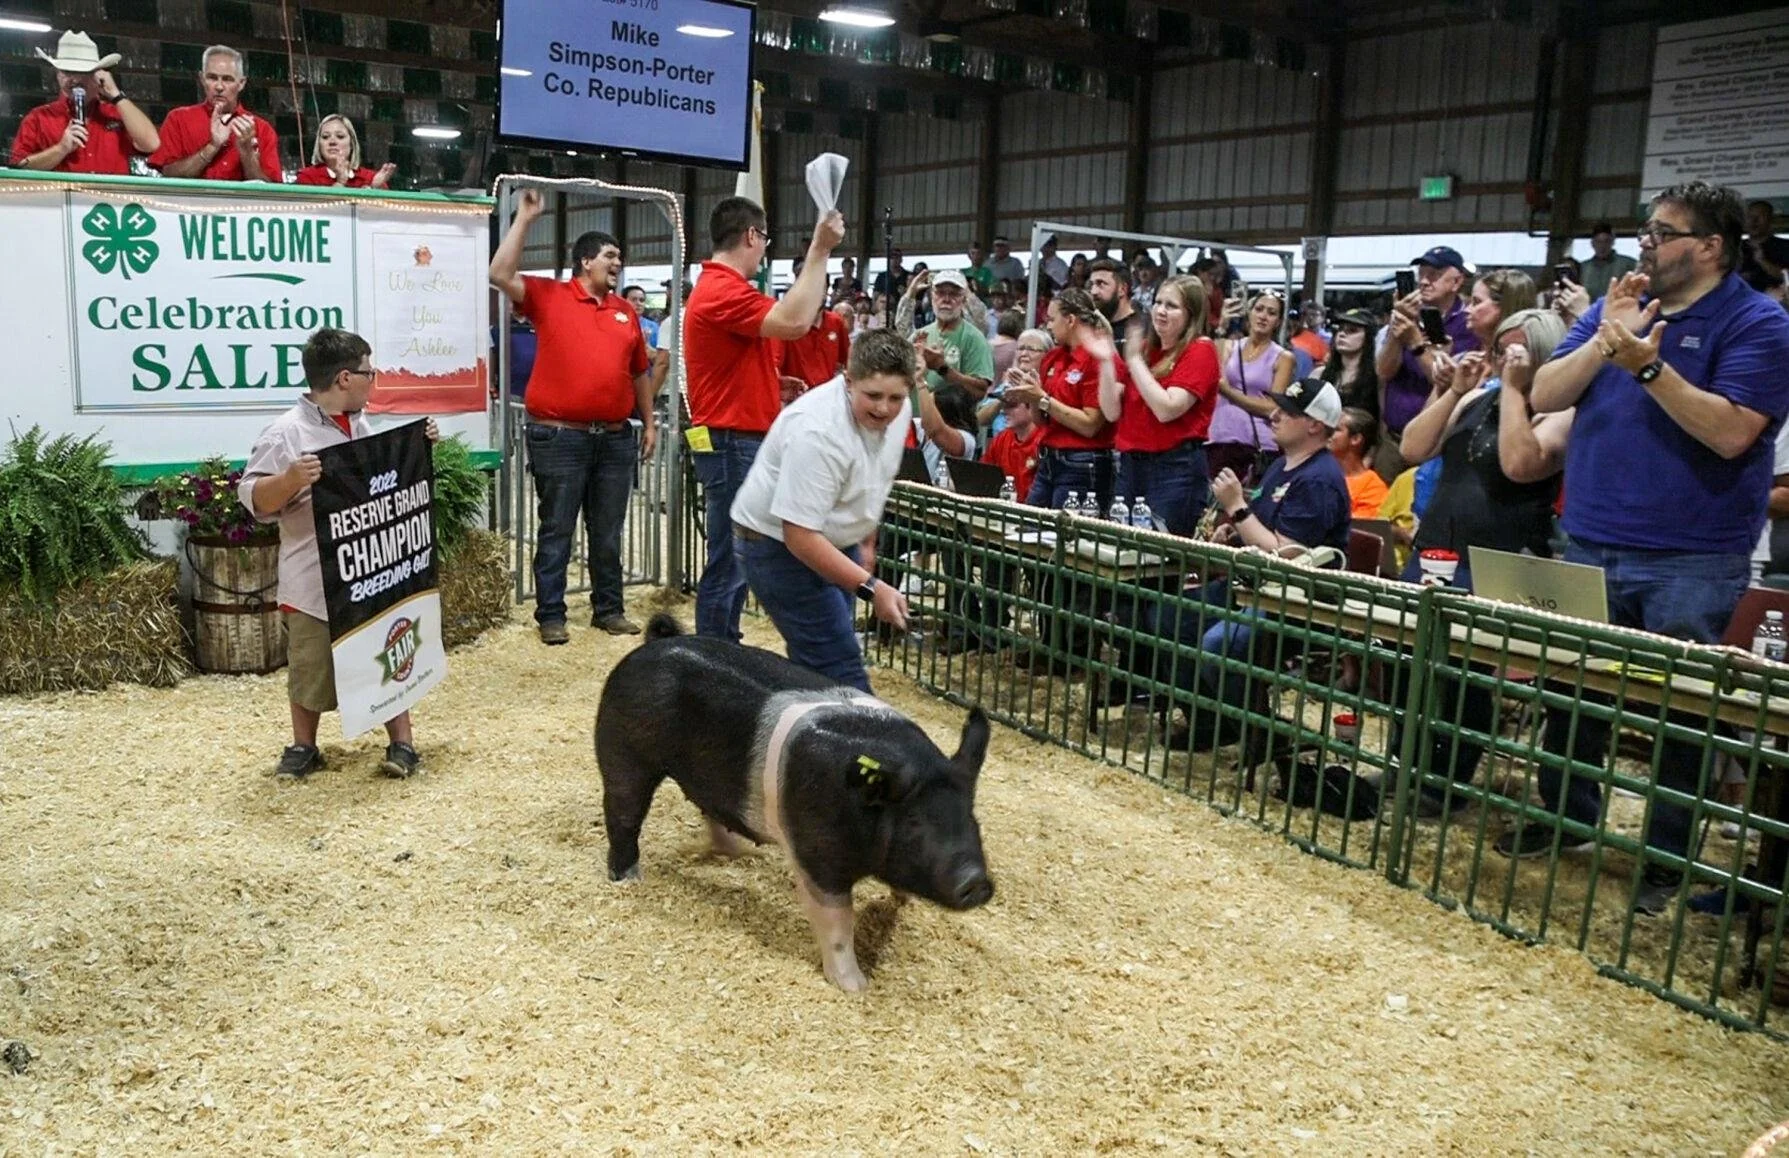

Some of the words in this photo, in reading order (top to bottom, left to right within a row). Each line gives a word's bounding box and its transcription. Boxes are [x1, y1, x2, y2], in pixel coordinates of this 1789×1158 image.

[612, 20, 660, 47] Mike
[549, 42, 715, 85] Simpson-Porter
[544, 72, 580, 96] Co.
[588, 78, 716, 115] Republicans
[179, 214, 332, 264] WELCOME
[388, 271, 415, 292] We
[421, 271, 465, 293] Love
[87, 296, 346, 330] Celebration
[411, 306, 442, 331] You
[132, 343, 309, 392] SALE
[401, 337, 458, 357] Ashlee
[369, 470, 398, 495] 2022
[329, 495, 394, 540] RESERVE
[394, 480, 430, 517] GRAND
[337, 509, 431, 582] CHAMPION
[350, 560, 412, 602] BREEDING
[387, 630, 415, 673] FAIR
